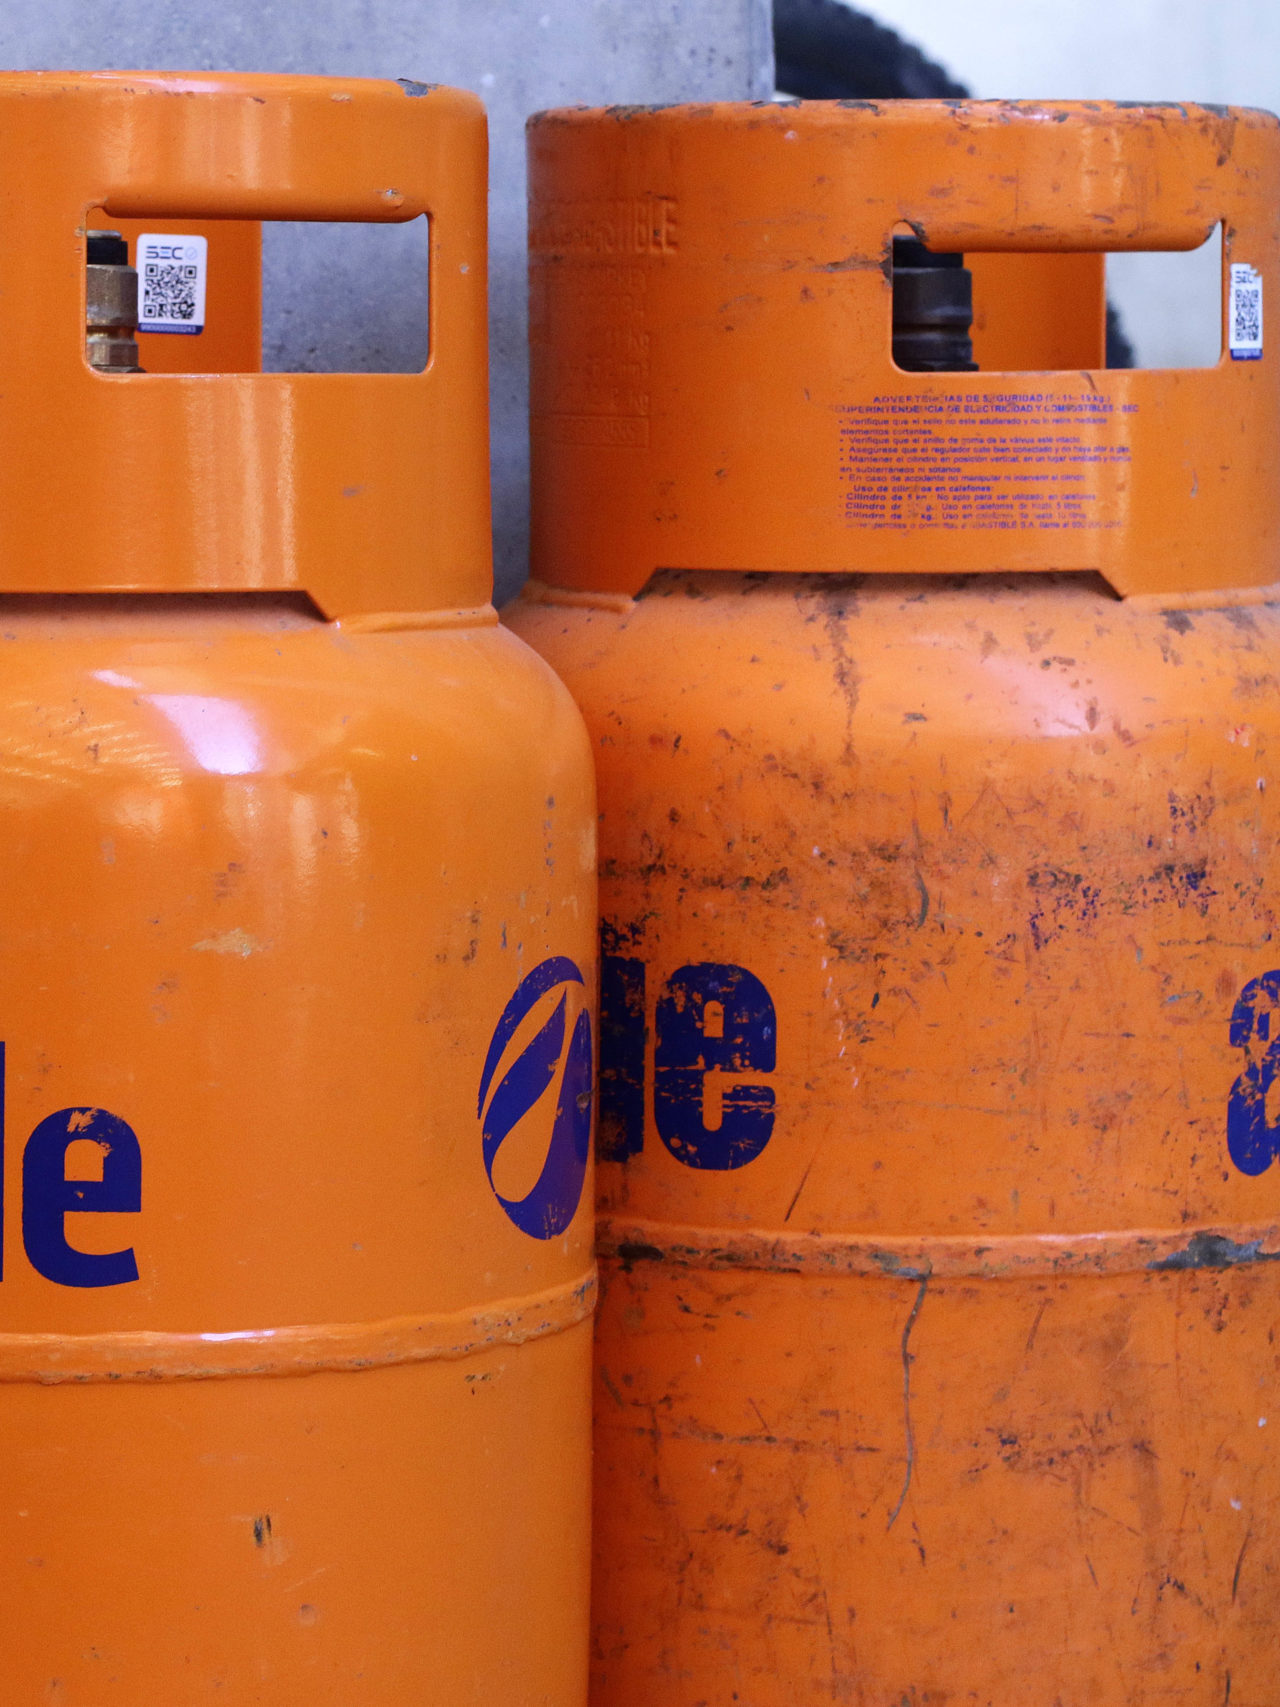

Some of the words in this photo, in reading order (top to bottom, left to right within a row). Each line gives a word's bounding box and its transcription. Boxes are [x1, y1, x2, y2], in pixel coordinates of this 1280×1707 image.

[145, 246, 184, 260] SEC
[873, 394, 962, 403] ADVERTEIAS
[835, 404, 943, 413] UPERINTENDECIA
